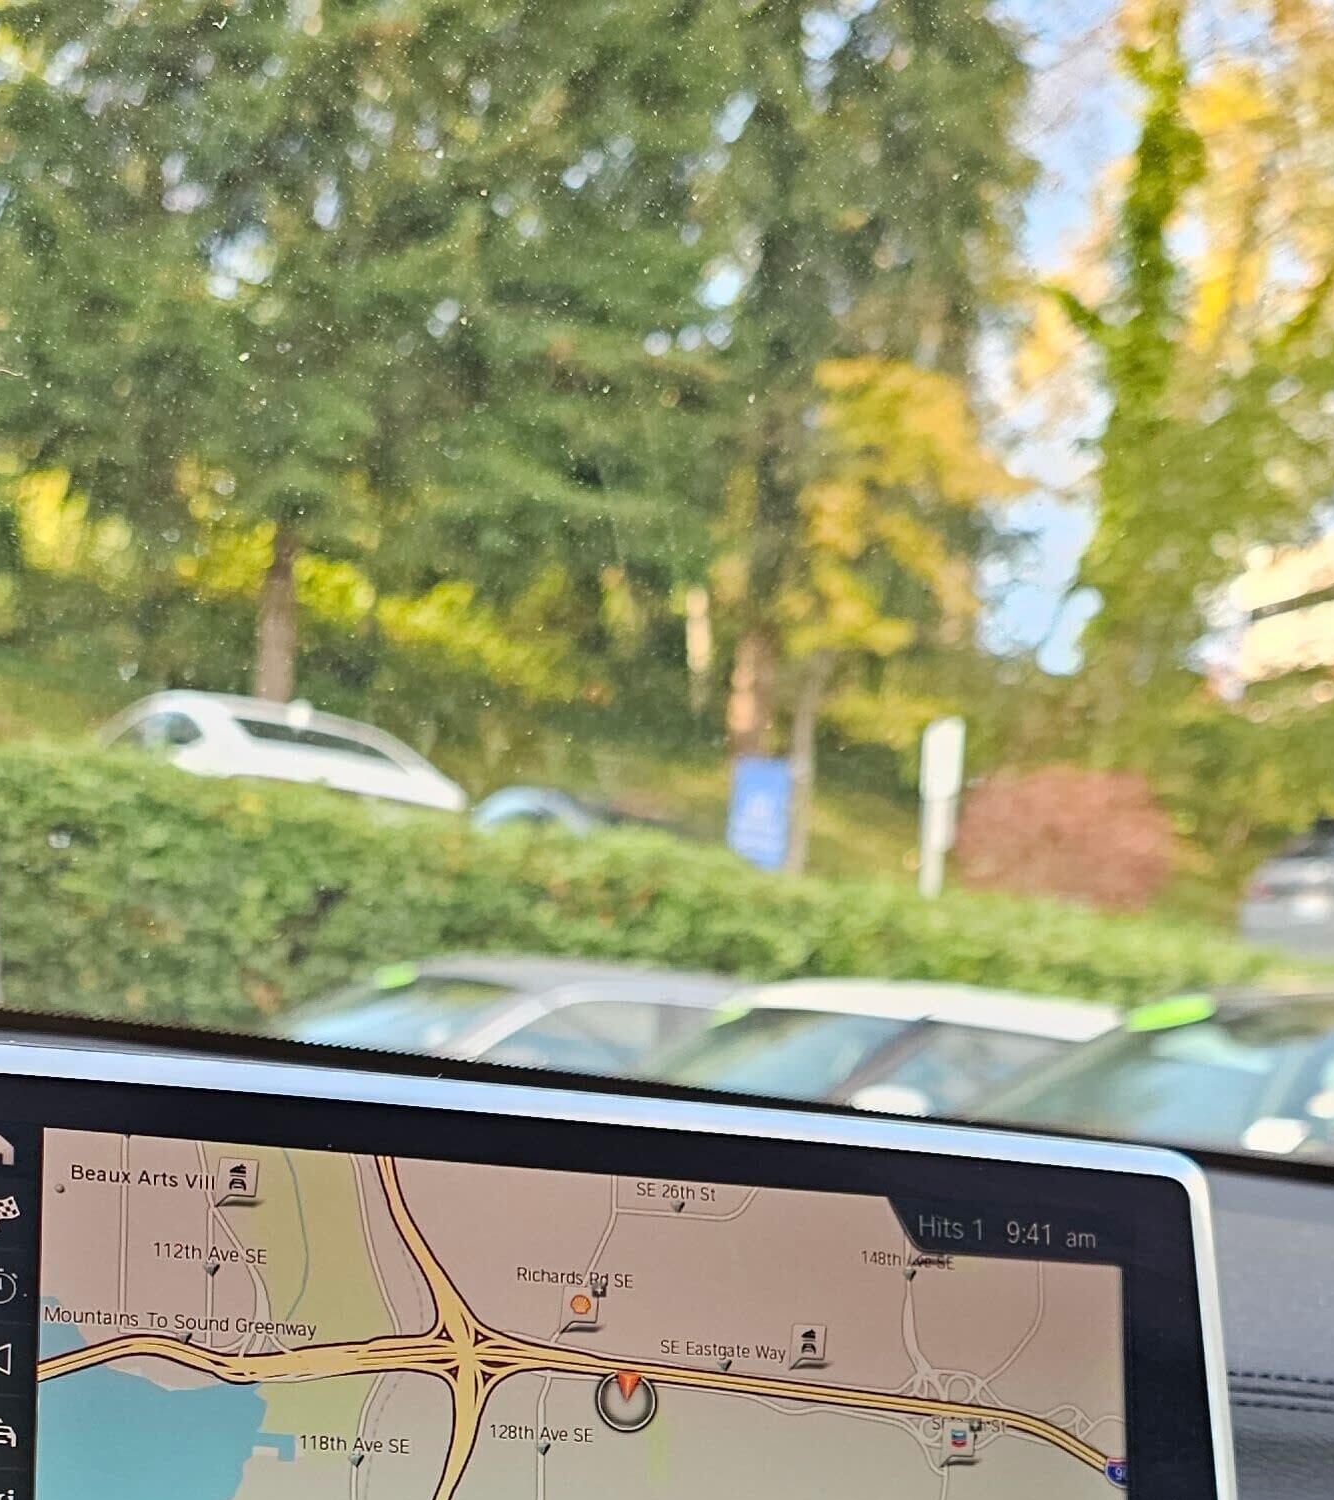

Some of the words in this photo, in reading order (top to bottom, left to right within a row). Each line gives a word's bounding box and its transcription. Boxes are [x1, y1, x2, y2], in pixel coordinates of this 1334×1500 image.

[71, 1164, 131, 1184] Beaux
[137, 1169, 179, 1188] Arts
[184, 1173, 216, 1191] Vill
[636, 1182, 657, 1198] SE
[662, 1182, 696, 1201] 26th
[699, 1185, 716, 1202] St
[918, 1214, 965, 1240] Hits
[973, 1219, 983, 1240] 1
[1007, 1220, 1052, 1245] 9:41
[1066, 1232, 1096, 1249] am
[153, 1242, 202, 1260] 112th
[208, 1246, 239, 1263] Ave
[245, 1248, 268, 1265] SE
[861, 1250, 902, 1267] 148th
[517, 1266, 584, 1286] Richards
[589, 1271, 609, 1287] Rd
[614, 1273, 634, 1289] SE
[44, 1306, 139, 1328] Mountains
[146, 1311, 168, 1329] To
[174, 1314, 229, 1332] Sound
[235, 1317, 317, 1341] Greenway
[660, 1339, 682, 1356] SE
[685, 1341, 751, 1363] Eastgate
[754, 1344, 787, 1363] Way
[299, 1433, 346, 1453] 118th
[351, 1436, 384, 1454] Ave
[388, 1438, 410, 1456] SE
[489, 1423, 535, 1442] 128th
[540, 1426, 569, 1443] Ave
[572, 1427, 594, 1444] SE
